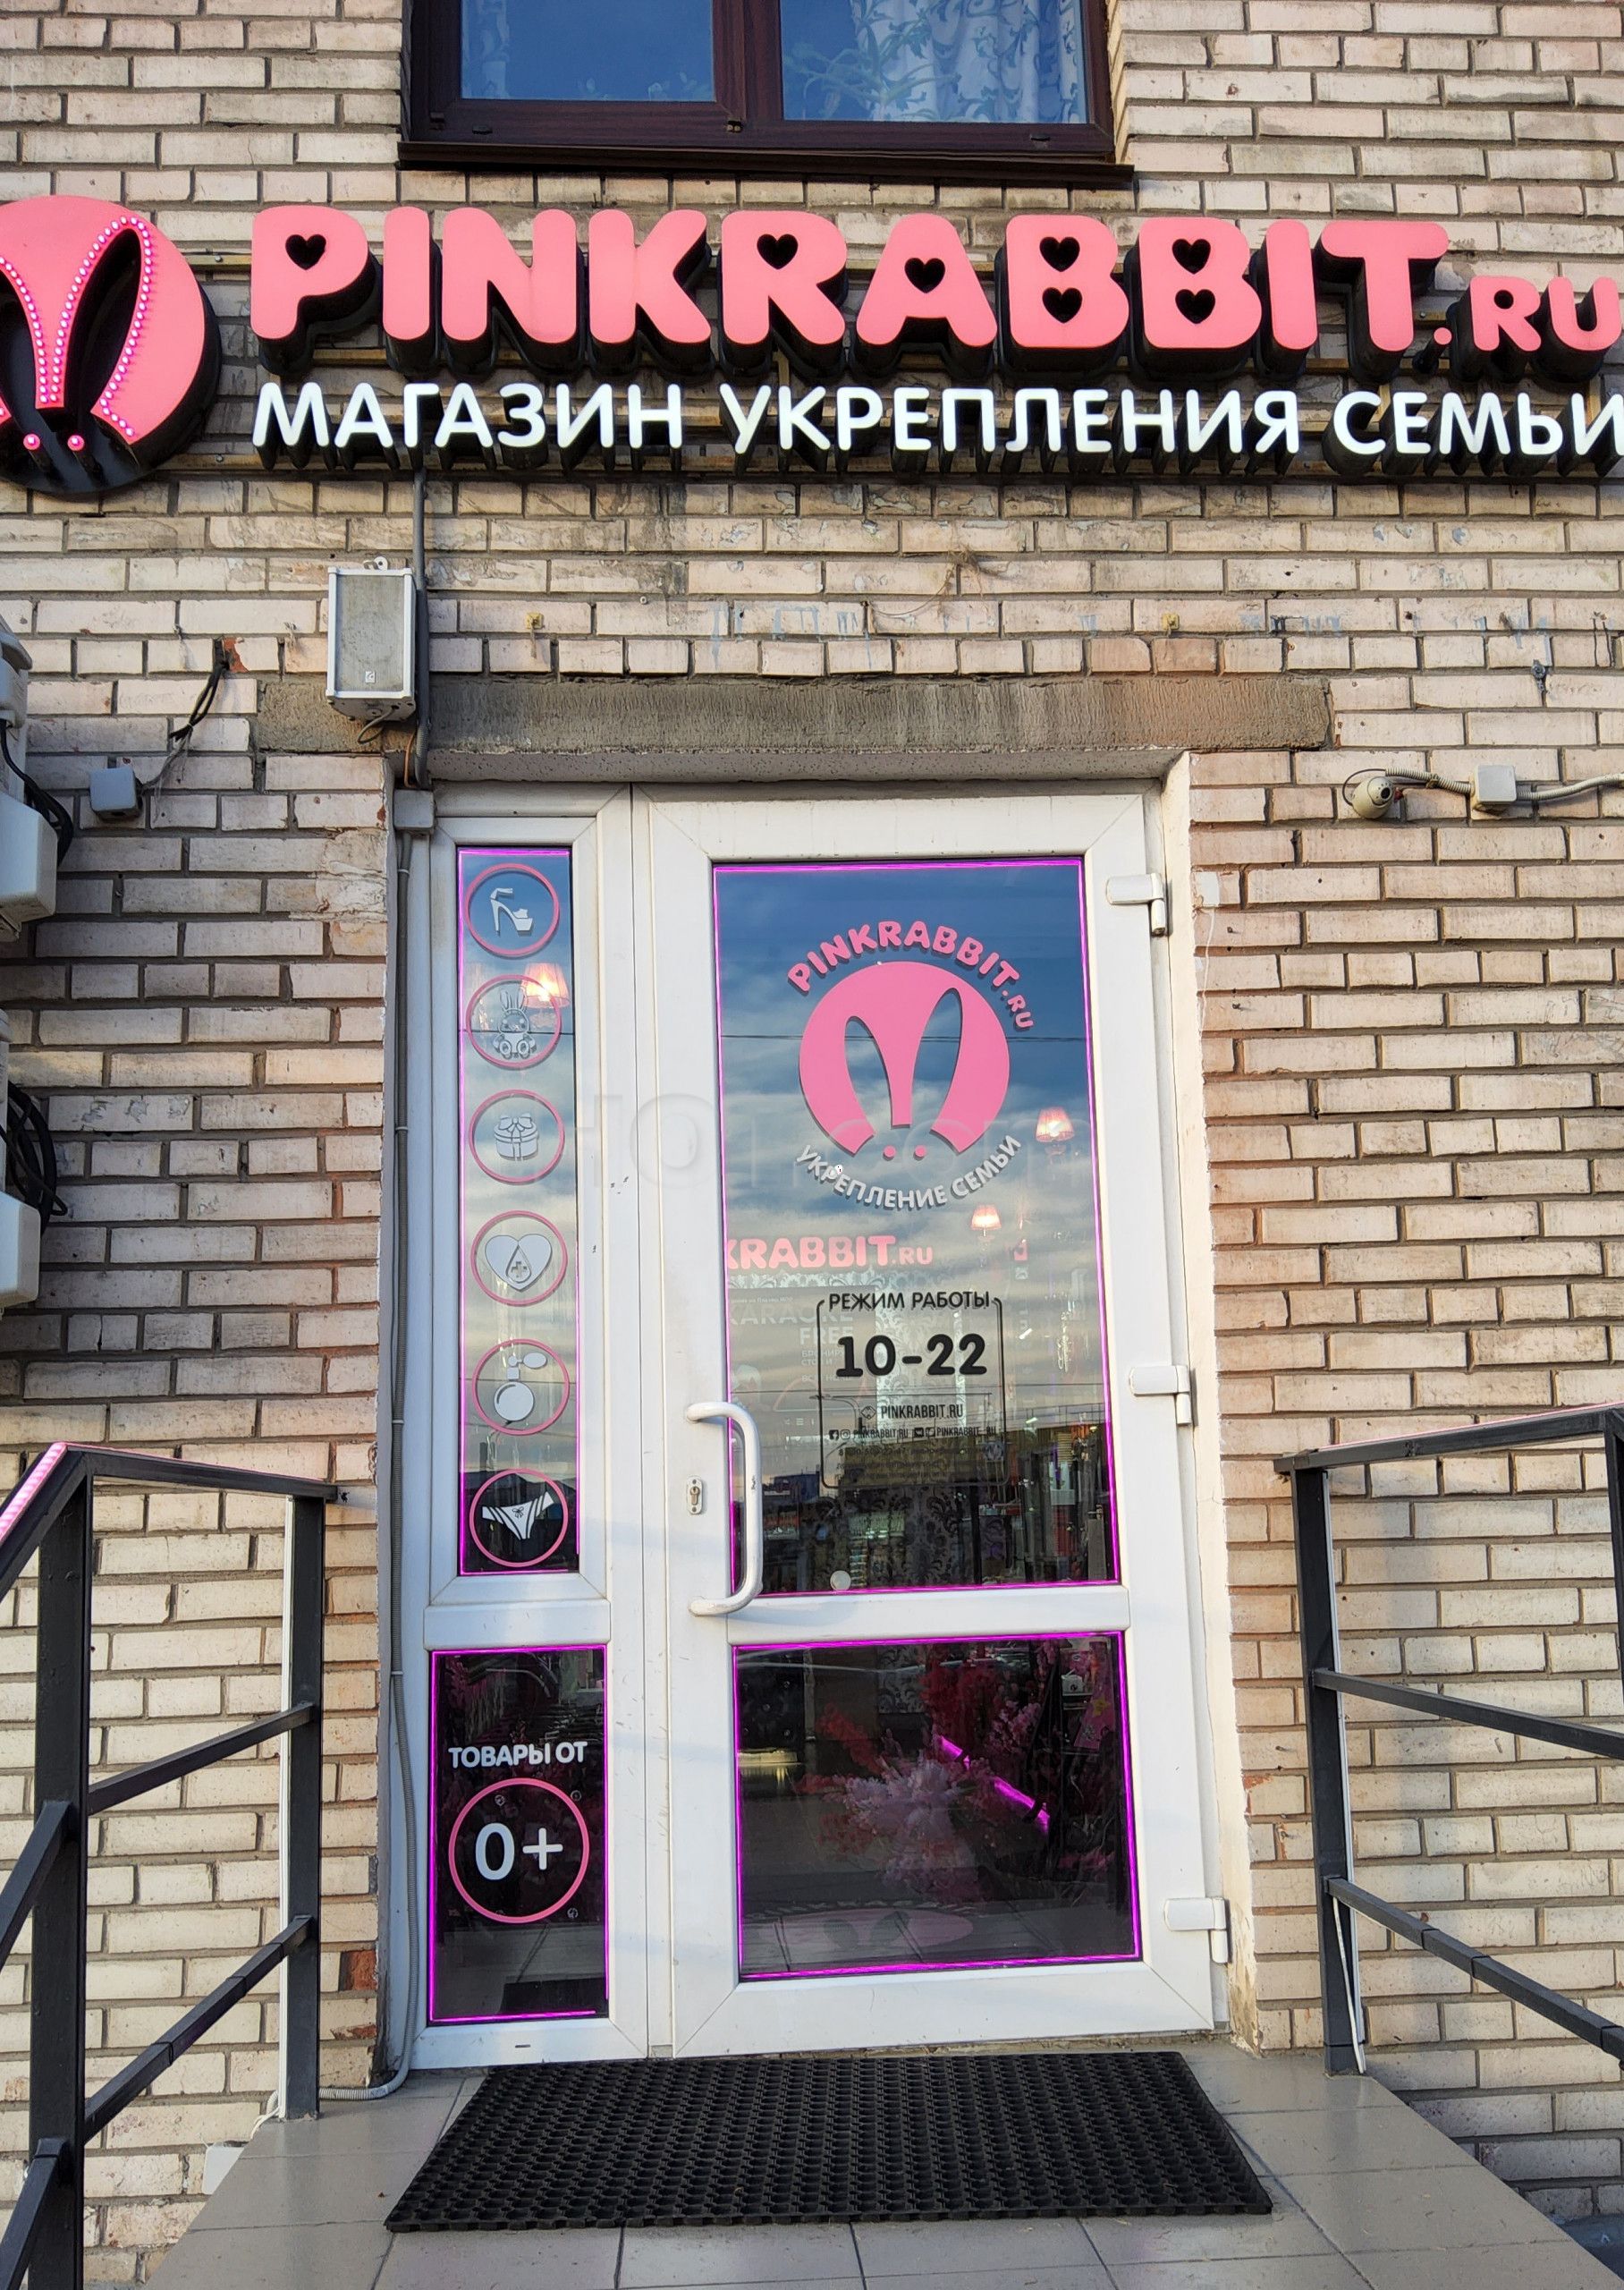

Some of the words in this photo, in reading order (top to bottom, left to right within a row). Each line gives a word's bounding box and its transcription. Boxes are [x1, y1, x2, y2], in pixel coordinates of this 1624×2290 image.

[251, 206, 1621, 352] PINKRABBIT.RU
[253, 382, 683, 449] МАГАЗИН
[719, 384, 1300, 455] УКРЕПЛЕНИЯ
[1333, 390, 1624, 456] СЕМЬИ
[787, 920, 1034, 1029] PINKRABBIT.RU
[796, 1145, 948, 1209] УКРЕПЛЕНИЕ
[951, 1135, 1022, 1197] СЕМЬИ
[829, 1293, 905, 1311] РЕЖИМ
[912, 1291, 989, 1309] РАБОТЫ
[836, 1333, 987, 1377] 10-22
[881, 1404, 963, 1420] PINKRABBIT.RU
[448, 1743, 551, 1768] ТОВАРЫ
[554, 1741, 588, 1764] ОТ
[475, 1821, 563, 1880] 0+
